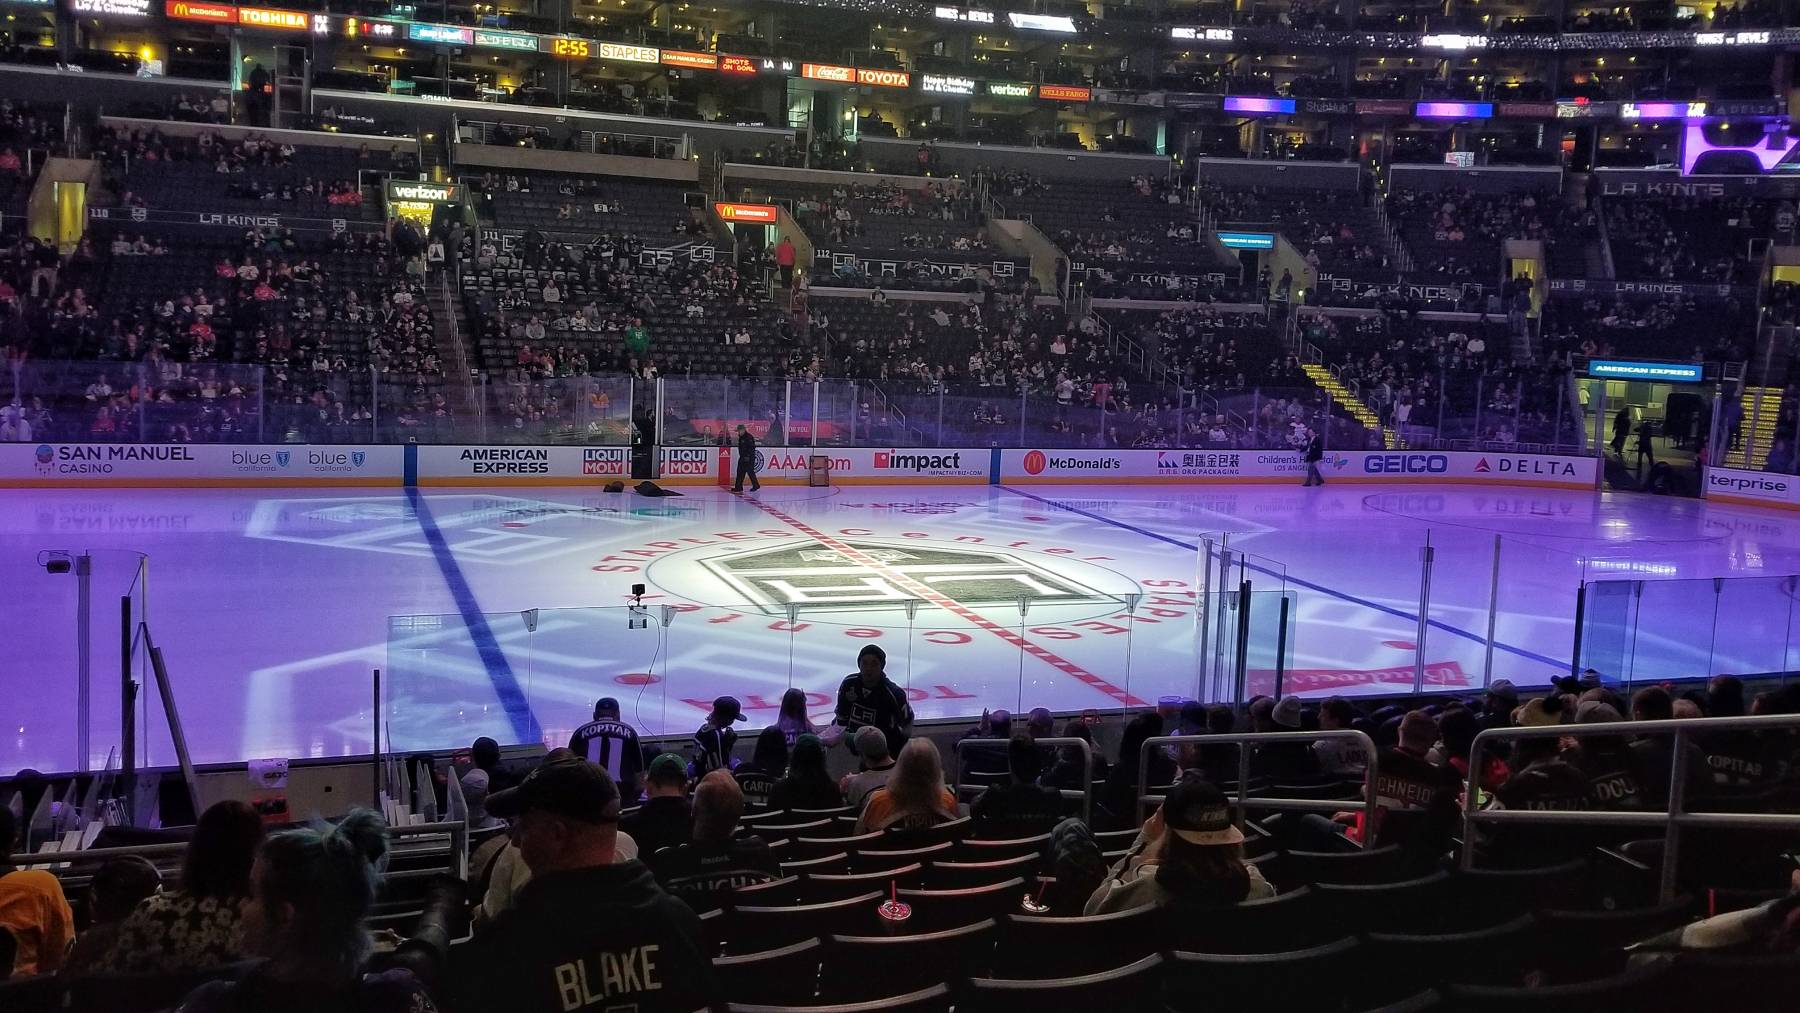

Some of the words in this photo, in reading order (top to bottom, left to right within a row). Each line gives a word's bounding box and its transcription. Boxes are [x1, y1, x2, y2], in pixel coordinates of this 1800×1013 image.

[241, 9, 305, 26] TOSHIBA
[492, 36, 537, 49] DELTA
[1696, 32, 1725, 44] KINGS
[1737, 32, 1771, 44] DEVILS
[555, 39, 588, 57] 12:55
[601, 44, 657, 62] STAPLES
[725, 58, 750, 66] SHOTS
[736, 65, 756, 73] GOAL
[763, 59, 775, 69] LA
[858, 70, 909, 86] TOYOTA
[923, 75, 946, 86] Happy
[946, 77, 975, 89] Birthday
[990, 84, 1029, 97] verizon
[1040, 89, 1065, 97] WELLS
[1065, 90, 1089, 98] FARGO
[395, 186, 448, 200] verizon
[1603, 182, 1638, 195] LA
[200, 213, 222, 225] LA
[227, 214, 279, 228] KINGS
[816, 249, 830, 258] 112
[1319, 273, 1333, 281] 114
[1615, 282, 1635, 291] LA
[1638, 283, 1683, 293] KINGS
[1595, 365, 1649, 374] AMERICAN
[1650, 368, 1696, 377] EXPRESS
[59, 446, 101, 460] SAN
[108, 446, 195, 461] MANUEL
[232, 450, 271, 465] blue
[308, 450, 347, 465] blue
[460, 449, 548, 461] AMERICAN
[585, 450, 623, 462] LIQUI
[670, 450, 706, 462] LIQUI
[890, 449, 960, 472] impact
[1182, 453, 1241, 467] 奥瑞金包装
[1257, 455, 1297, 465] Children's
[59, 463, 113, 474] CASINO
[473, 462, 549, 474] EXPRESS
[585, 462, 623, 474] MOLY
[669, 462, 707, 474] MOLY
[768, 454, 851, 470] AAAom
[1049, 458, 1121, 469] McDonald's
[1364, 455, 1448, 473] GEICO
[1499, 458, 1576, 476] DELTA
[1709, 475, 1787, 491] terprise
[592, 529, 797, 573] STAPLES
[838, 528, 1117, 561] Center
[851, 704, 876, 722] LA
[581, 723, 633, 739] KOPITAR
[587, 737, 623, 782] 11
[743, 780, 776, 794] CART
[1376, 776, 1432, 802] CHNEID
[555, 945, 663, 1012] BLAKE
